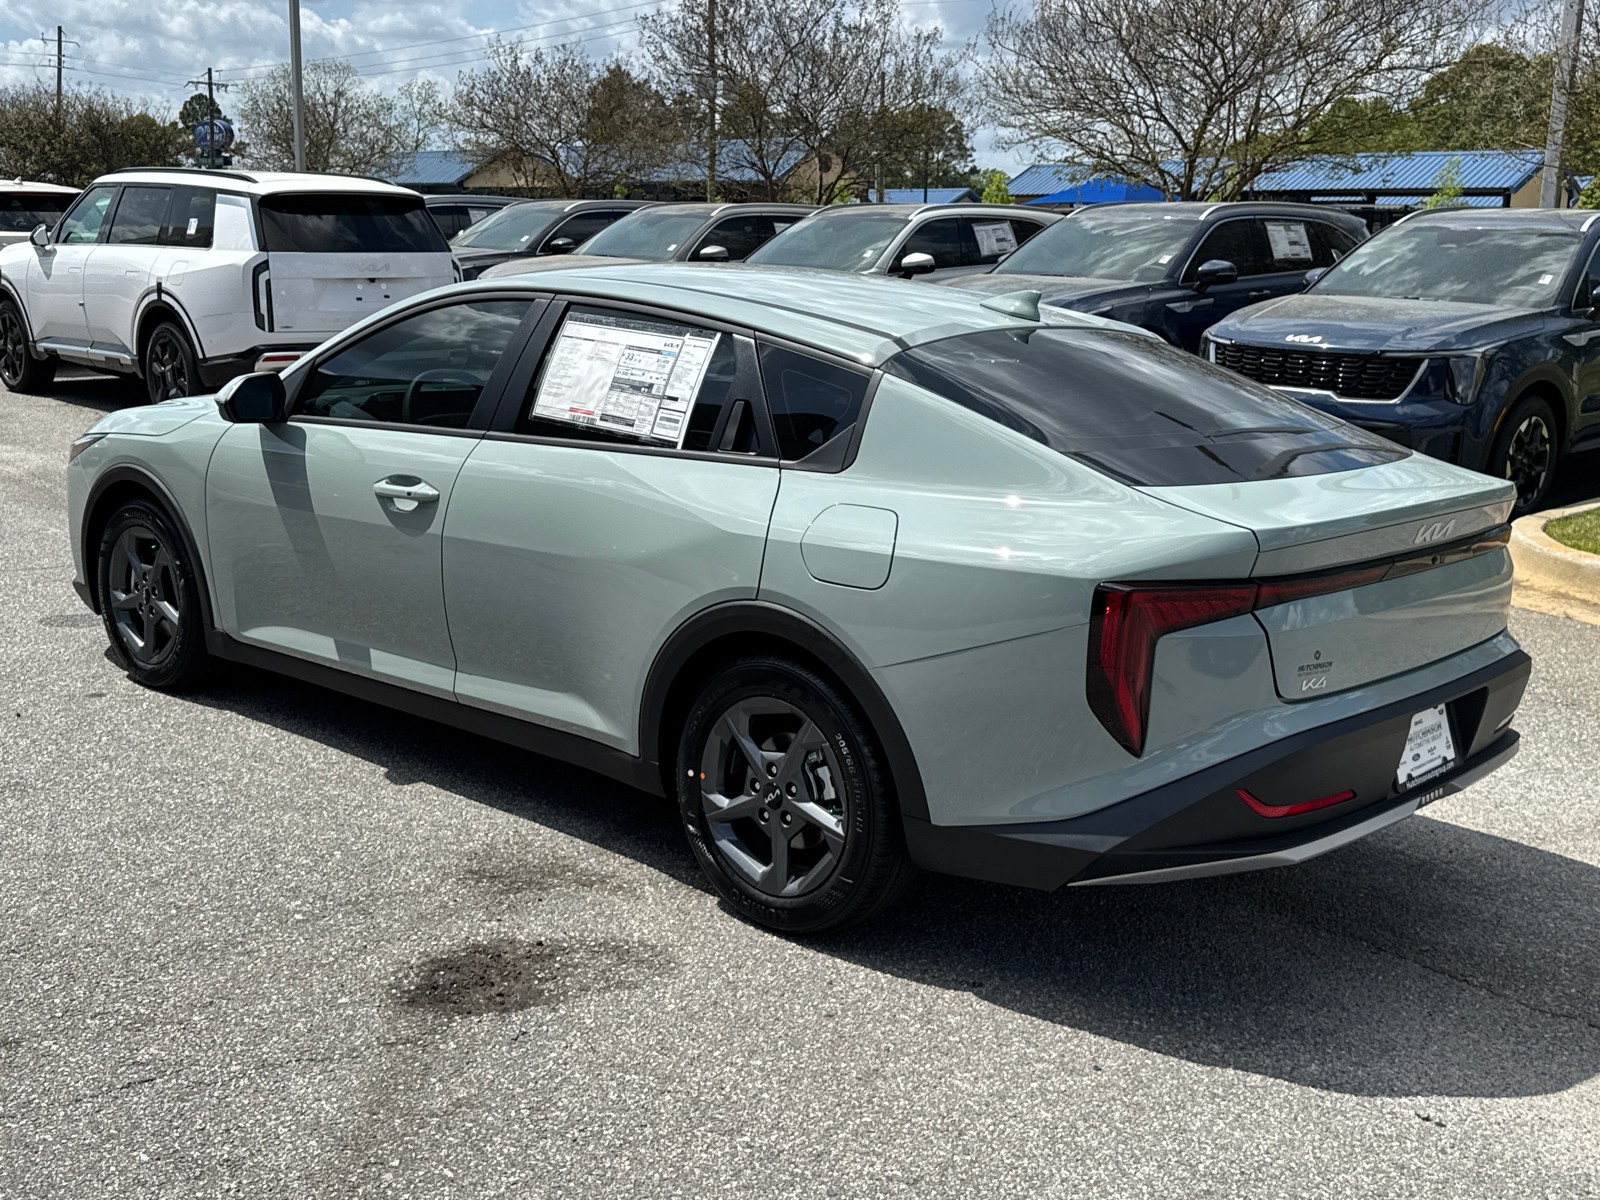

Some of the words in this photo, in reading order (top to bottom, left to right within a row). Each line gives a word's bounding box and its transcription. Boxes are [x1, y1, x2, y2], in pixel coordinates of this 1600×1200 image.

[1284, 334, 1323, 343] KIA
[1413, 518, 1456, 544] KIA
[1297, 661, 1333, 672] HUTCHINSON
[1301, 676, 1327, 691] K4
